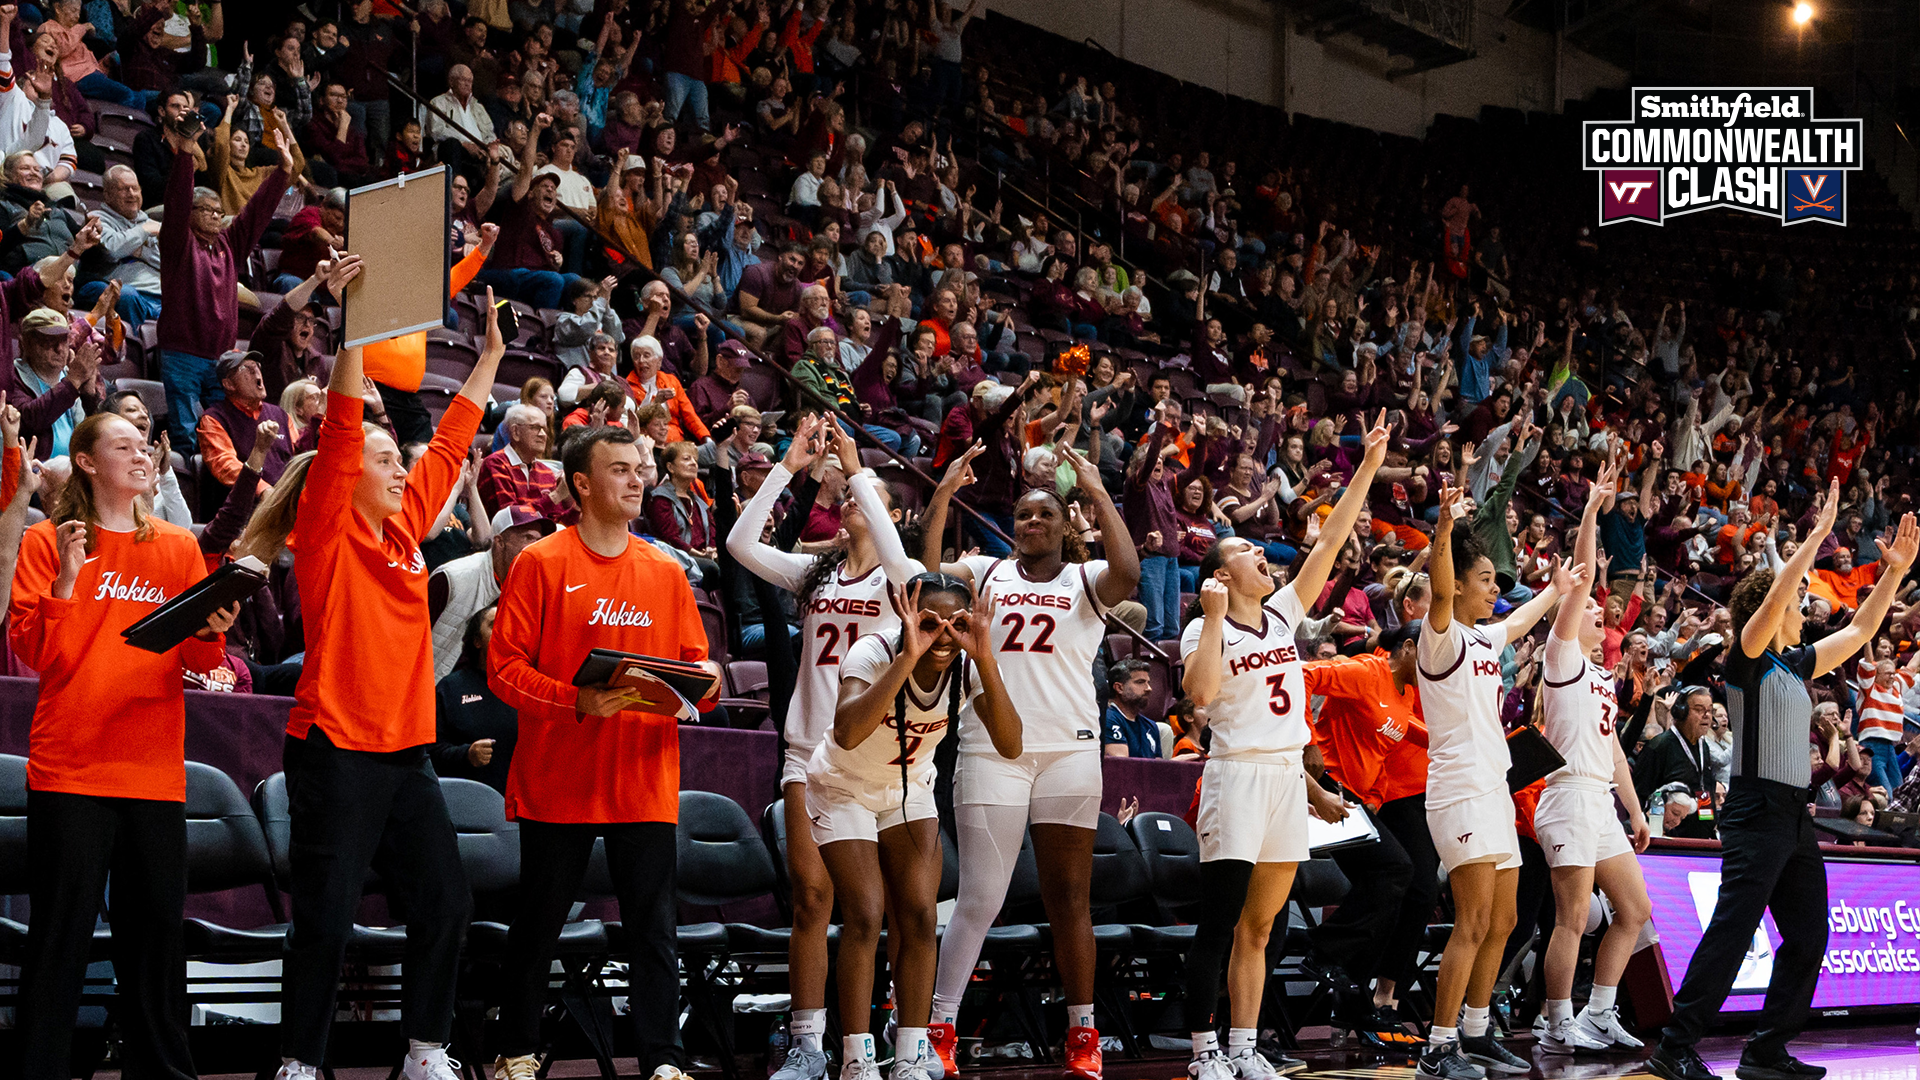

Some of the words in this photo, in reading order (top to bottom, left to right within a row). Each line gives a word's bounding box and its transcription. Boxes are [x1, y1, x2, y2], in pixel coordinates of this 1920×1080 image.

[94, 571, 167, 604] Hokies
[994, 592, 1072, 611] HOKIES
[588, 597, 653, 628] Hokies
[806, 597, 882, 618] HOKIES
[815, 622, 859, 667] 21
[999, 612, 1057, 654] 22
[1229, 645, 1297, 677] HOKIES
[1265, 671, 1292, 717] 3
[1111, 724, 1123, 740] 3
[886, 734, 924, 766] 2
